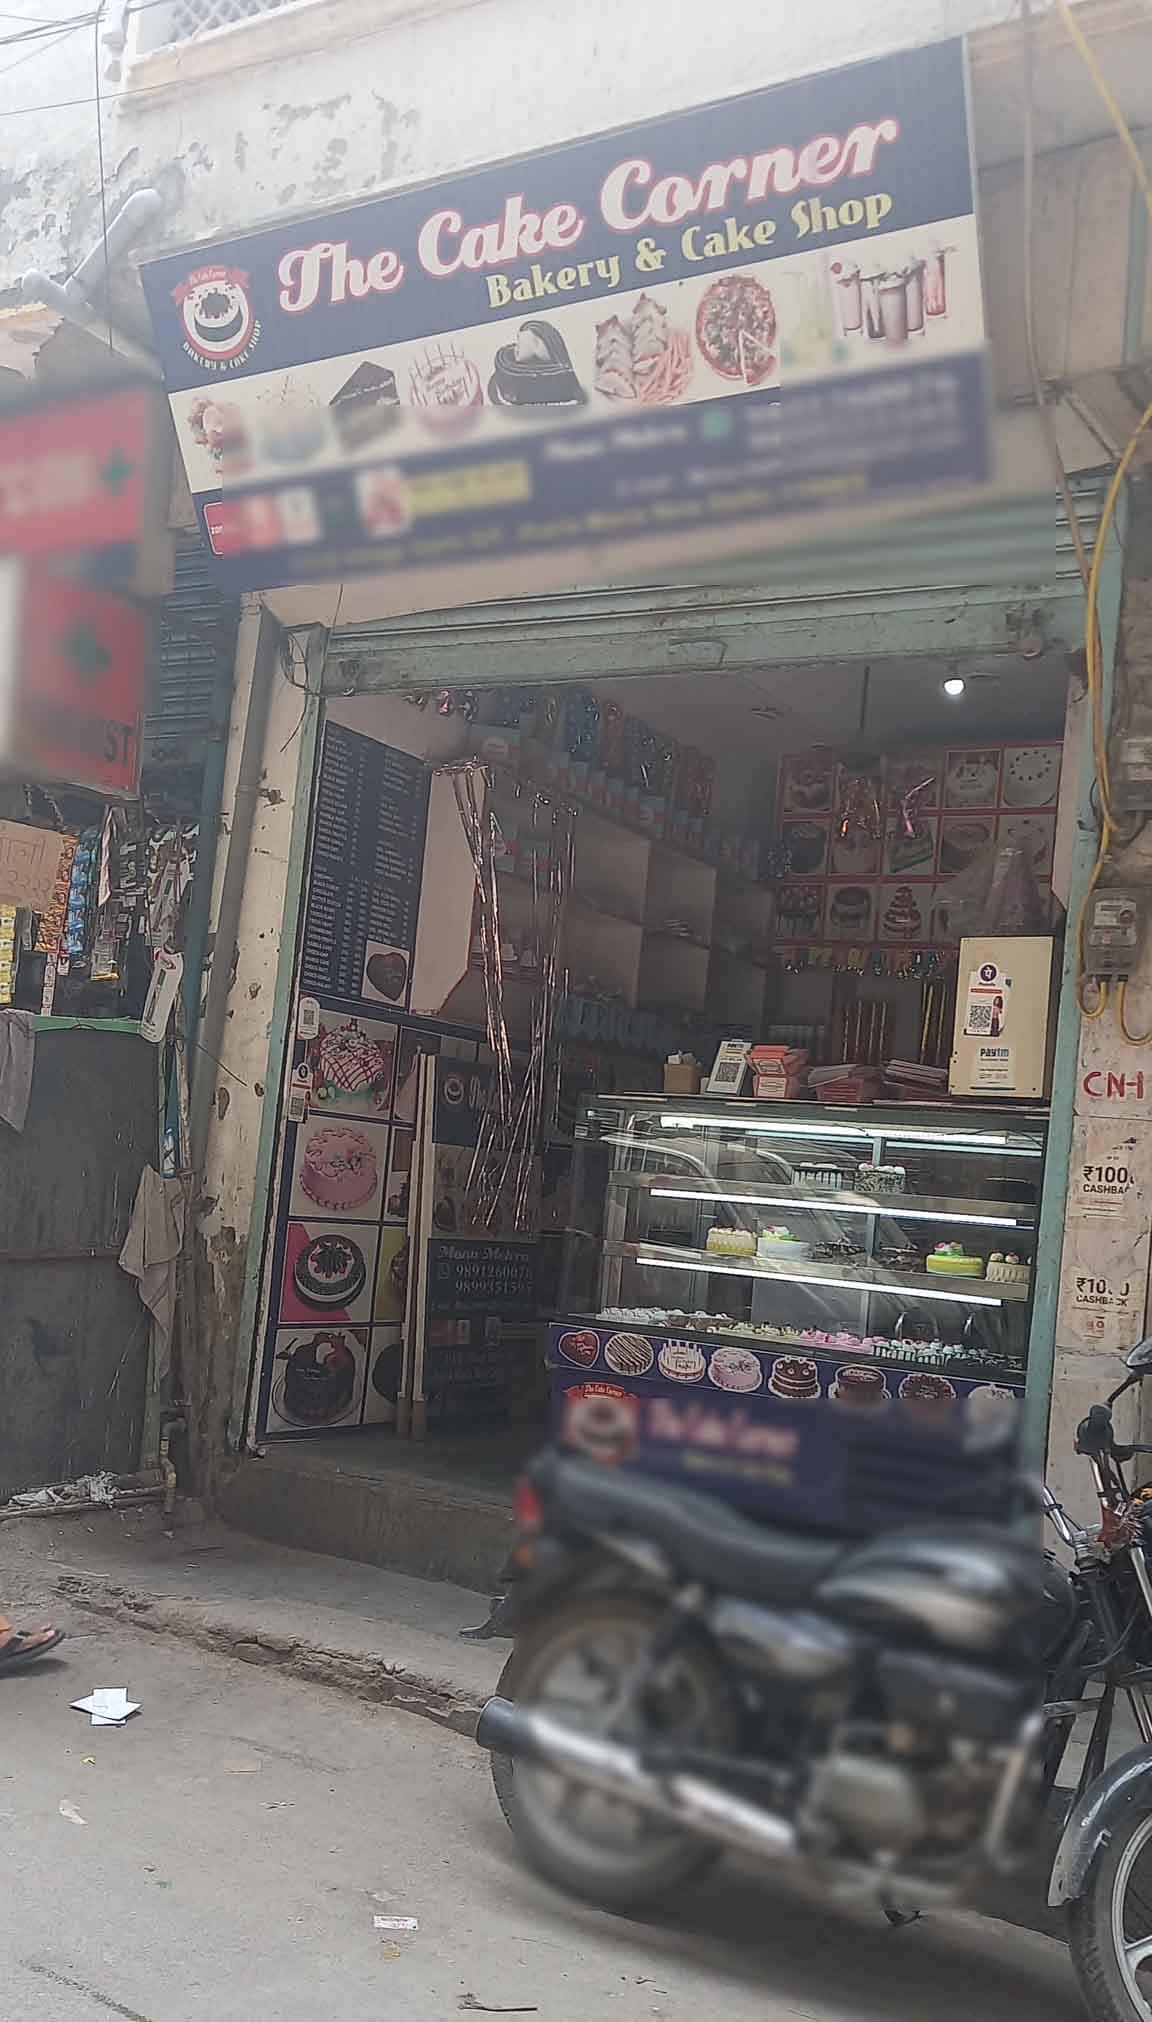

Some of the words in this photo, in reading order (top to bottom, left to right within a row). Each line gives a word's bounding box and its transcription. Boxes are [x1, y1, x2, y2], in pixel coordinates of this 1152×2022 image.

[278, 241, 404, 313] The
[418, 193, 585, 279] Cake
[601, 118, 898, 232] Corner
[485, 254, 621, 308] Bakery
[634, 237, 666, 273] &
[681, 217, 777, 263] Cake
[790, 191, 893, 239] Shop
